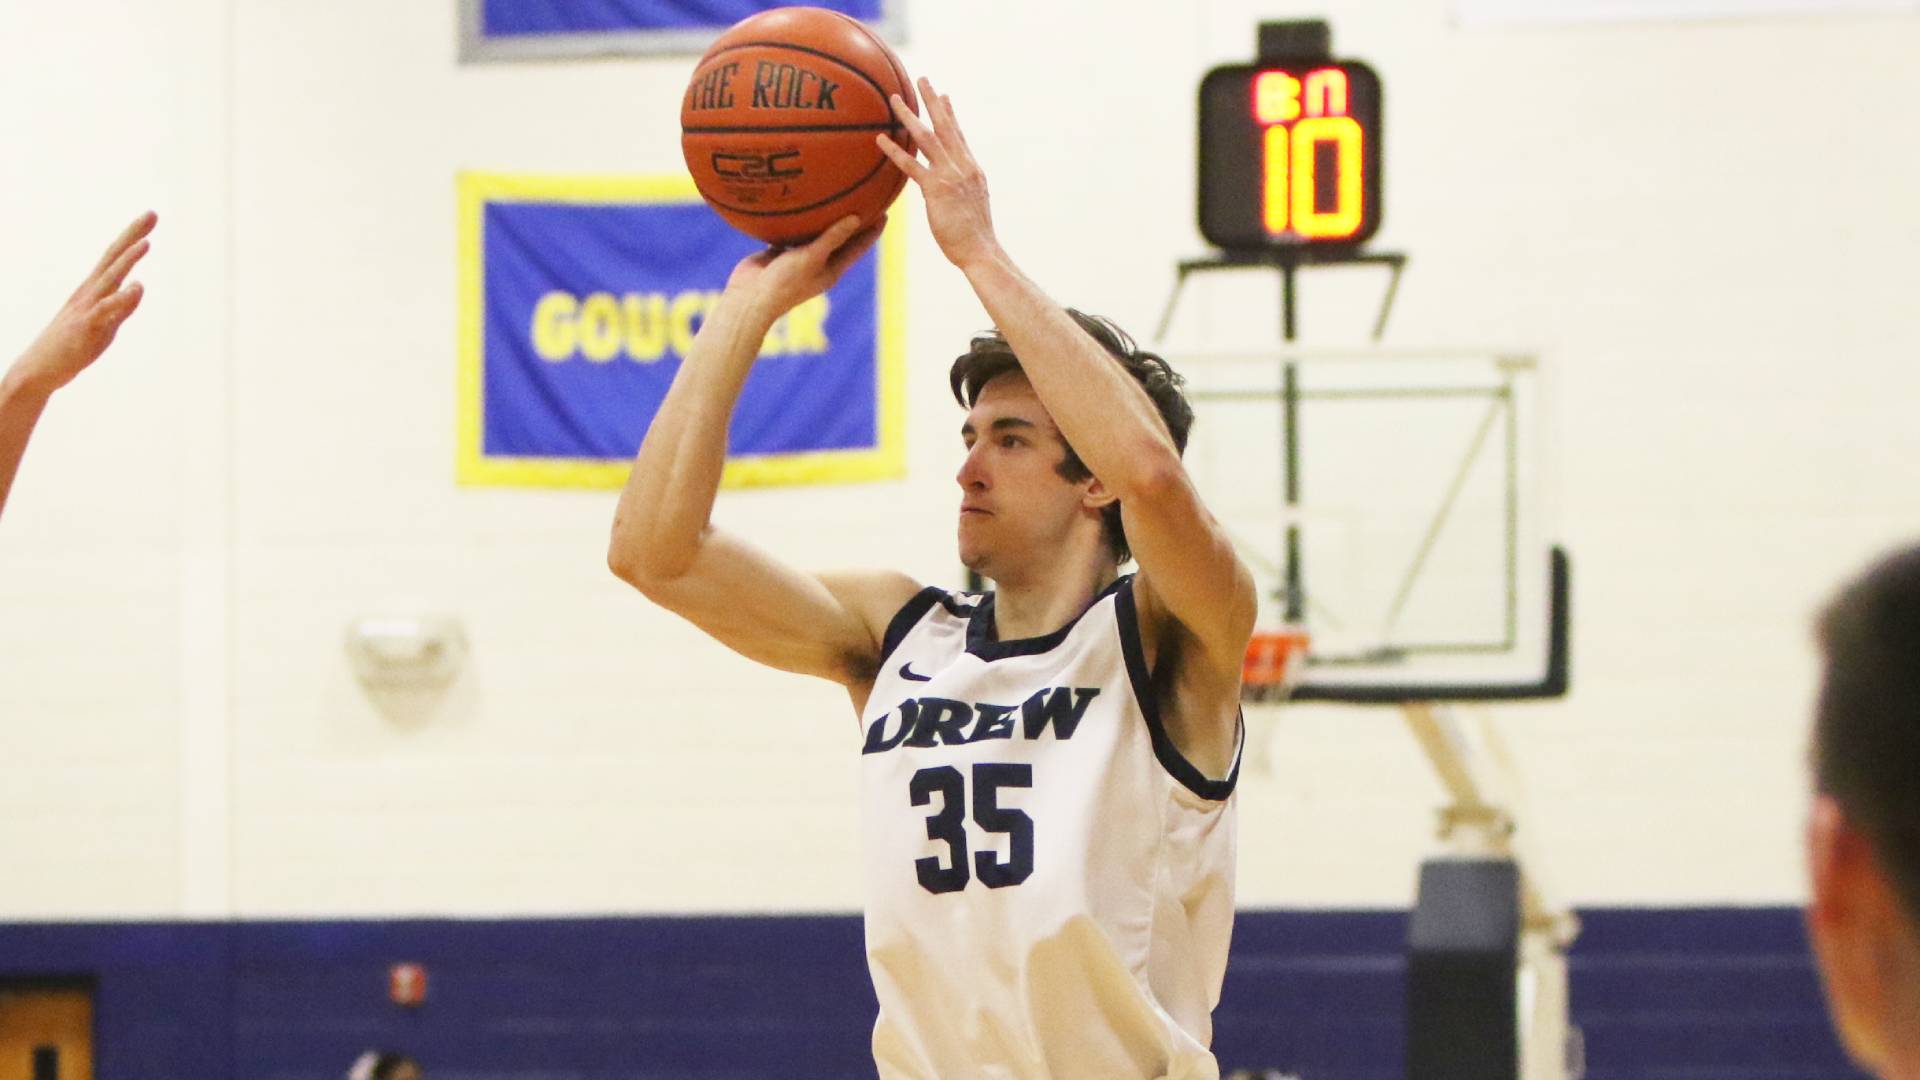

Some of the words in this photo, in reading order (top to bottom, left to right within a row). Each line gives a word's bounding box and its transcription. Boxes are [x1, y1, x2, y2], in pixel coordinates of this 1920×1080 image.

[691, 62, 740, 111] THE
[752, 59, 840, 111] ROCK
[1263, 116, 1363, 238] 10
[862, 687, 1101, 756] DREW
[909, 762, 1035, 895] 35
